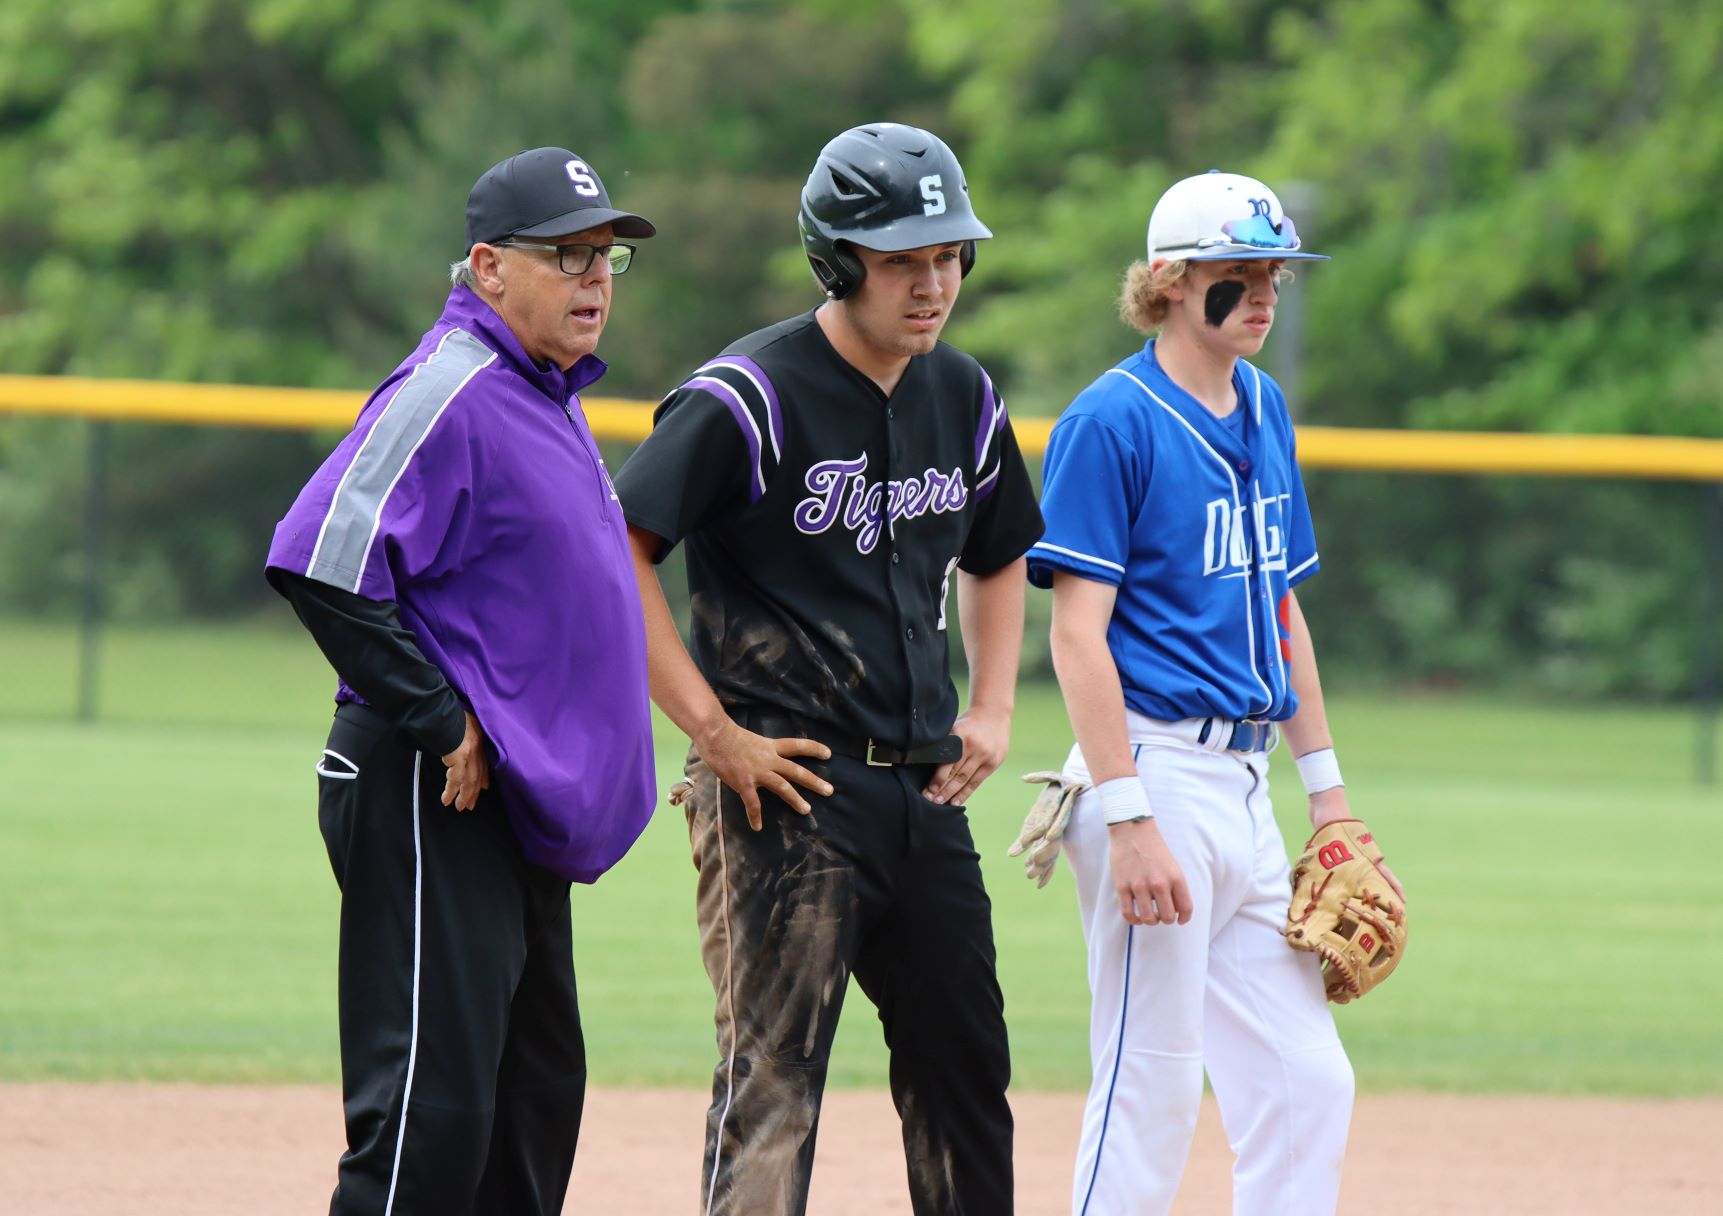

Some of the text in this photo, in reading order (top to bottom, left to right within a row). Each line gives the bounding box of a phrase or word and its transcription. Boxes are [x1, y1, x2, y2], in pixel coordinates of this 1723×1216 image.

[564, 159, 600, 197] S
[919, 174, 947, 217] S
[794, 451, 968, 554] Tigers
